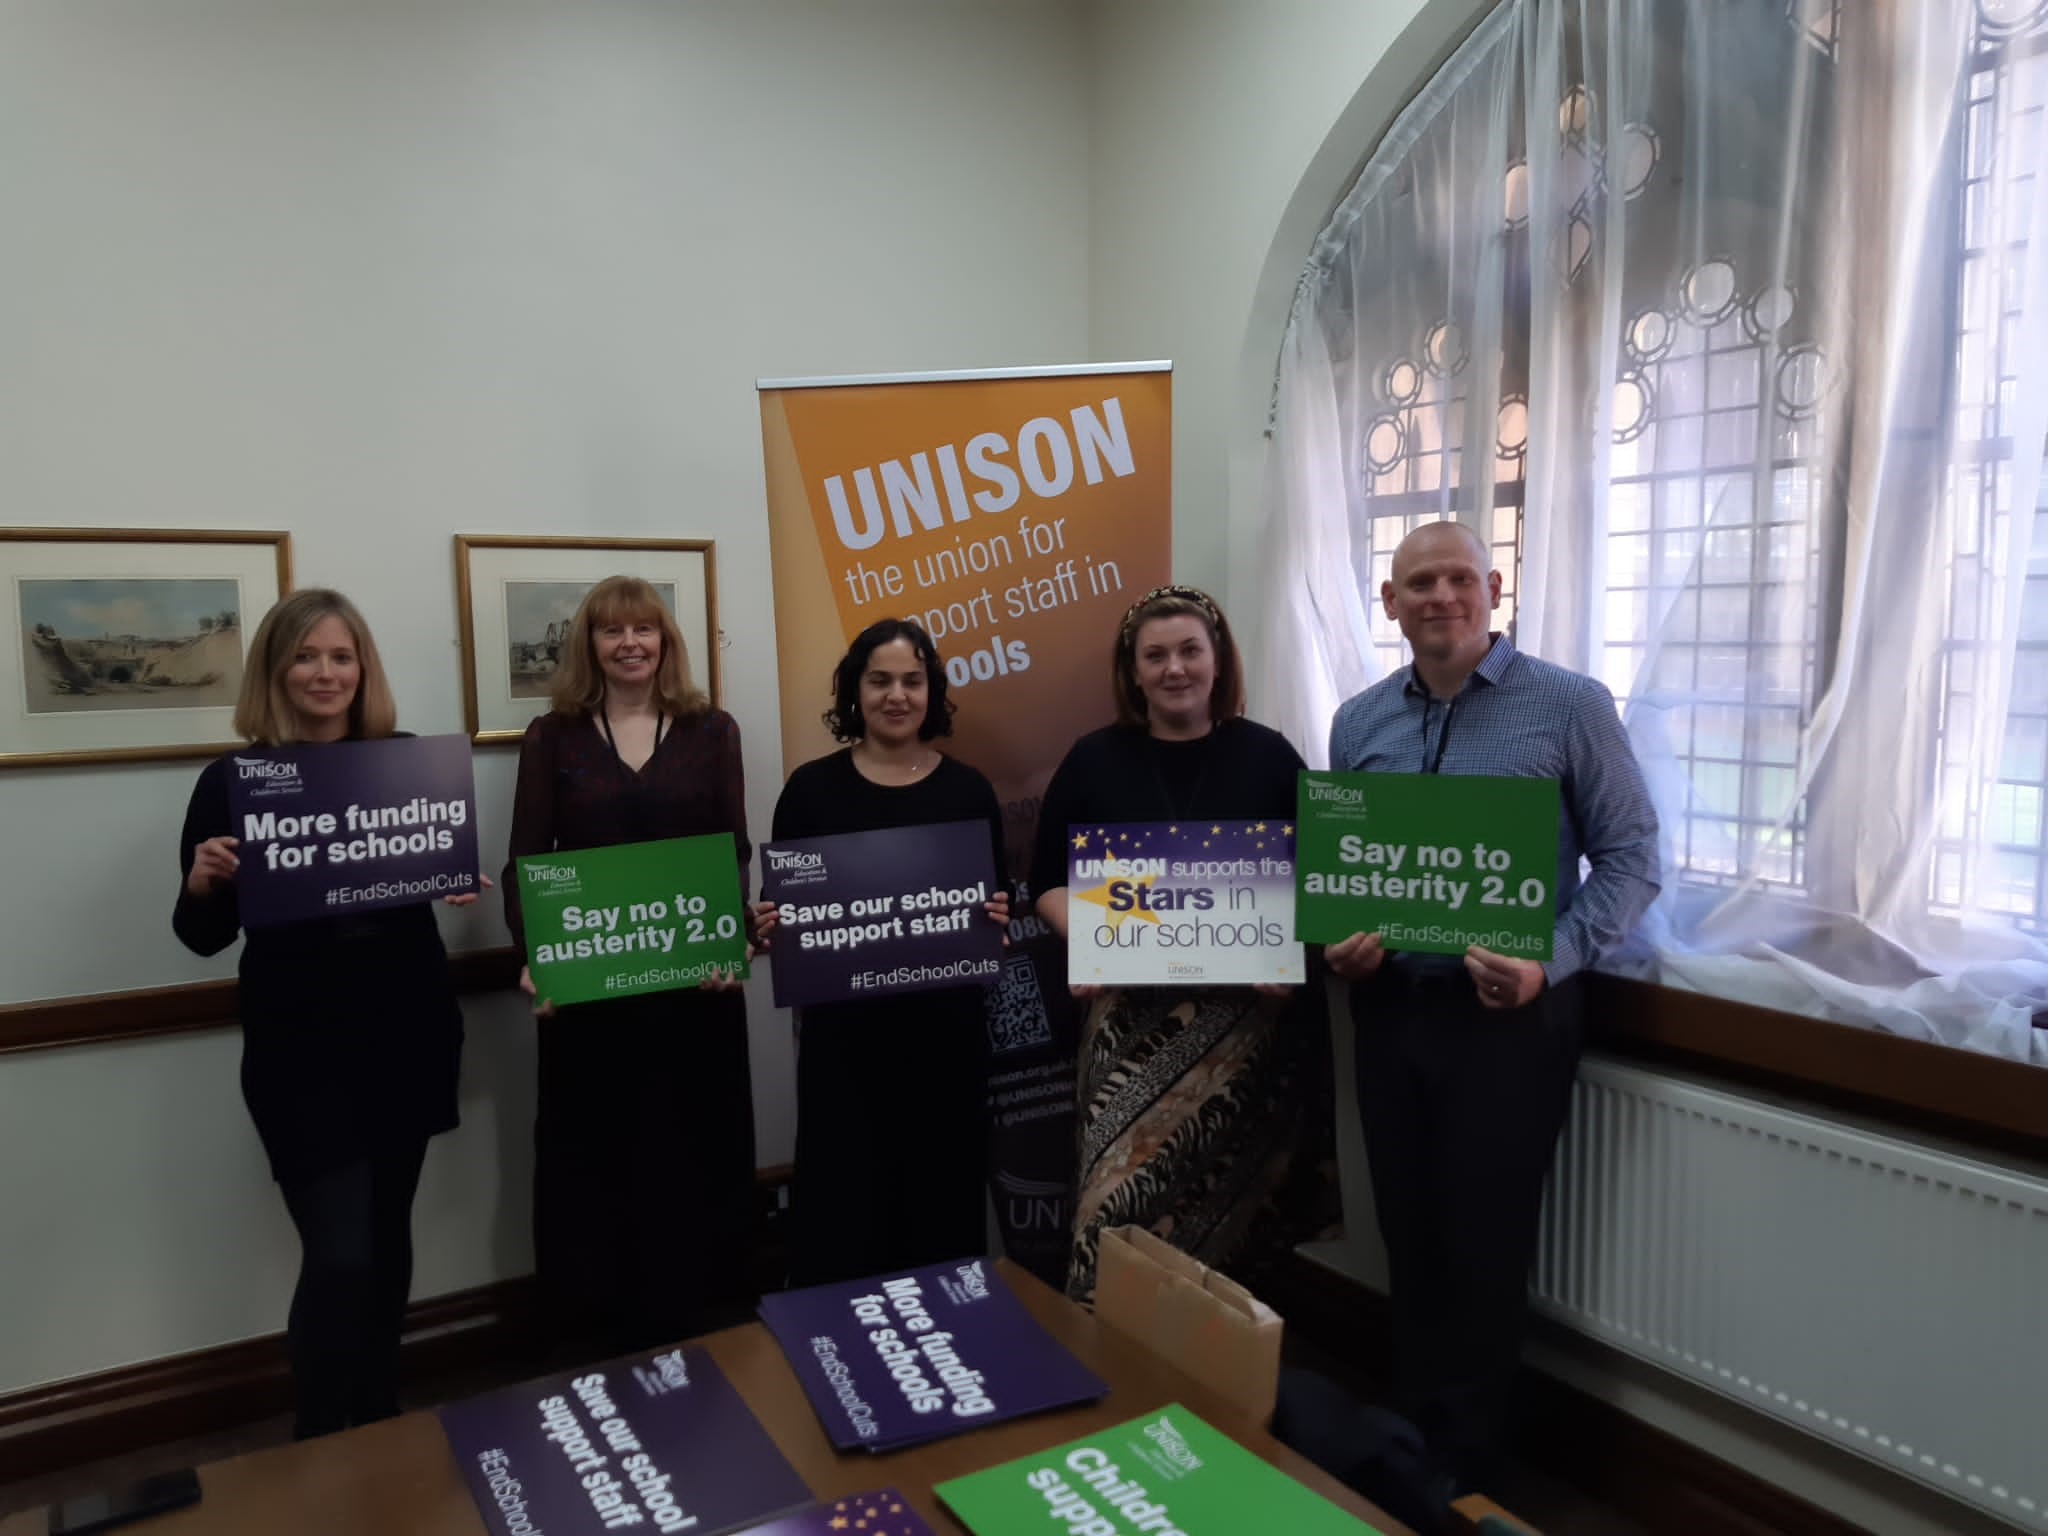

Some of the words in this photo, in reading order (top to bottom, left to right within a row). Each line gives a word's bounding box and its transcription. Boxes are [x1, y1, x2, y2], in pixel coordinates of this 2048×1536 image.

[824, 397, 1136, 549] UNISON
[845, 562, 905, 605] the
[914, 535, 1012, 589] union
[1019, 516, 1066, 559] for
[903, 588, 998, 648] port
[1005, 560, 1079, 618] staff
[1085, 555, 1123, 597] in
[946, 635, 1031, 687] ools
[239, 761, 297, 779] UNISON
[1308, 785, 1363, 801] UNISON
[244, 812, 337, 841] More
[345, 798, 467, 832] funding
[265, 841, 318, 871] for
[328, 826, 454, 863] schools
[771, 852, 822, 871] UNISON
[1339, 834, 1407, 872] Say
[1416, 846, 1462, 869] no
[1472, 843, 1511, 871] to
[325, 871, 473, 905] #EndSchoolCuts
[528, 864, 576, 882] UNISON
[1075, 858, 1166, 878] UNISON
[1172, 857, 1256, 881] supports
[1260, 857, 1292, 876] the
[778, 902, 844, 926] Save
[850, 896, 894, 917] our
[901, 882, 986, 911] school
[1107, 881, 1215, 911] Stars
[1229, 880, 1256, 910] in
[1304, 870, 1469, 910] austerity
[1480, 876, 1545, 907] 2.0
[562, 906, 621, 932] Say
[629, 901, 667, 923] no
[675, 894, 707, 916] to
[800, 917, 904, 950] support
[910, 909, 971, 936] staff
[1094, 923, 1149, 948] our
[1157, 916, 1284, 948] schools
[536, 926, 677, 965] austerity
[686, 914, 737, 943] 2.0
[1377, 923, 1545, 951] #EndSchoolCuts
[605, 960, 743, 990] #EndSchoolCuts
[850, 957, 999, 990] #EndSchoolCuts
[1009, 1199, 1060, 1231] UN
[850, 1294, 889, 1328] for
[883, 1276, 935, 1332] More
[917, 1330, 996, 1418] funding
[810, 1336, 879, 1438] #EndSchoolCuts
[869, 1326, 948, 1415] schools
[537, 1395, 608, 1474] support
[581, 1471, 645, 1530] staff
[572, 1373, 617, 1420] Save
[599, 1416, 641, 1453] our
[621, 1450, 699, 1534] school
[1144, 1423, 1203, 1472] UNISON
[477, 1447, 545, 1536] #EndSchool
